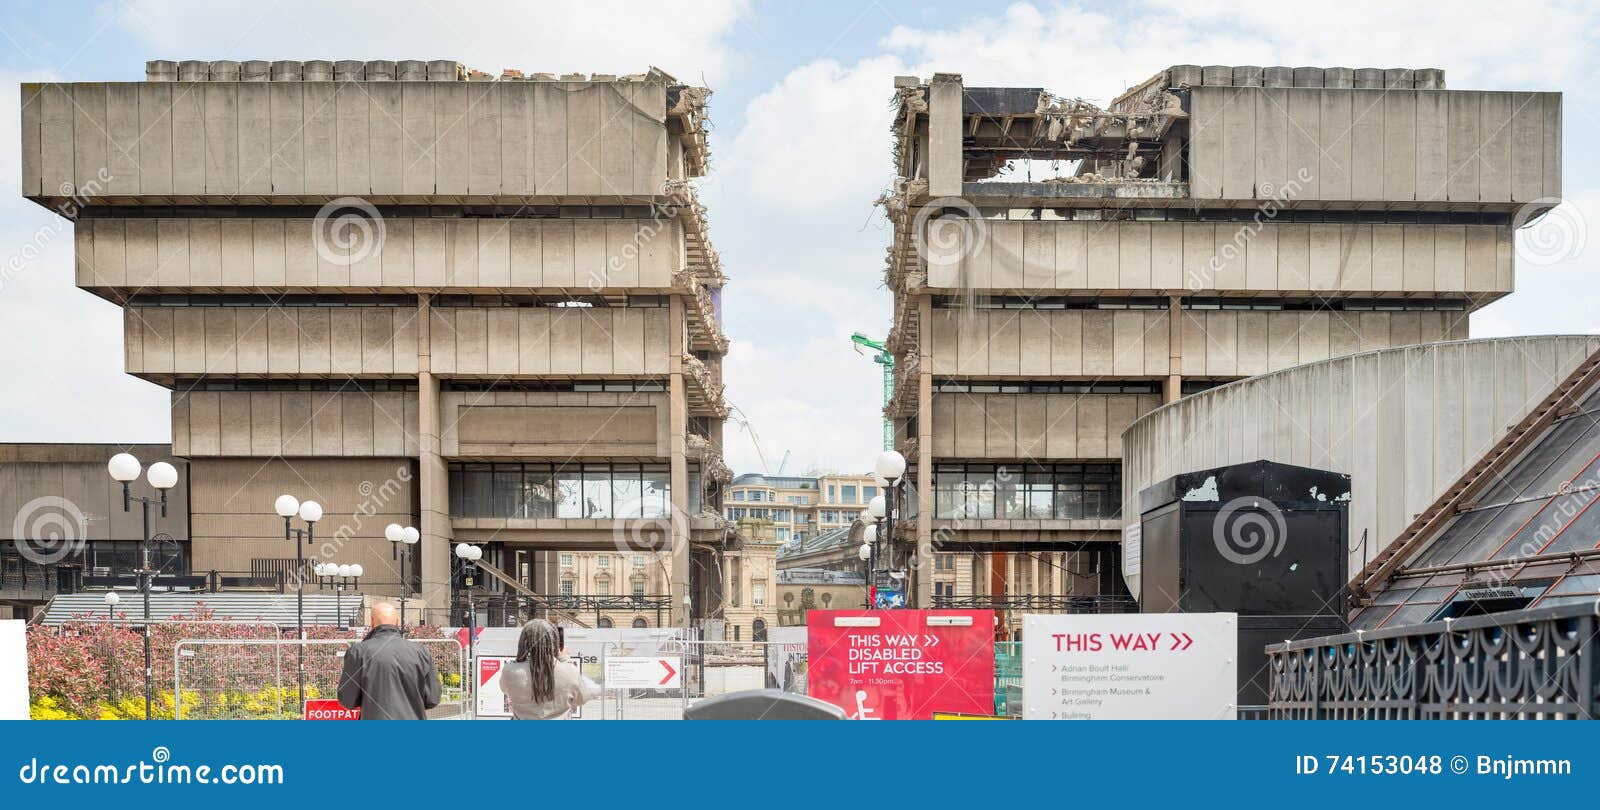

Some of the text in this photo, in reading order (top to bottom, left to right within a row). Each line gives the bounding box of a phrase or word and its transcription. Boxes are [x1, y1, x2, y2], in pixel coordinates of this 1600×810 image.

[849, 635, 918, 647] THIS WAY
[1052, 633, 1161, 651] THIS WAY
[848, 649, 922, 661] DISABLED
[849, 662, 944, 674] LIFT ACCESS
[1061, 674, 1108, 683] Birmingham
[1061, 688, 1108, 697] Birmingham
[1075, 698, 1102, 707] Gallery
[308, 710, 358, 719] FOOTPAT
